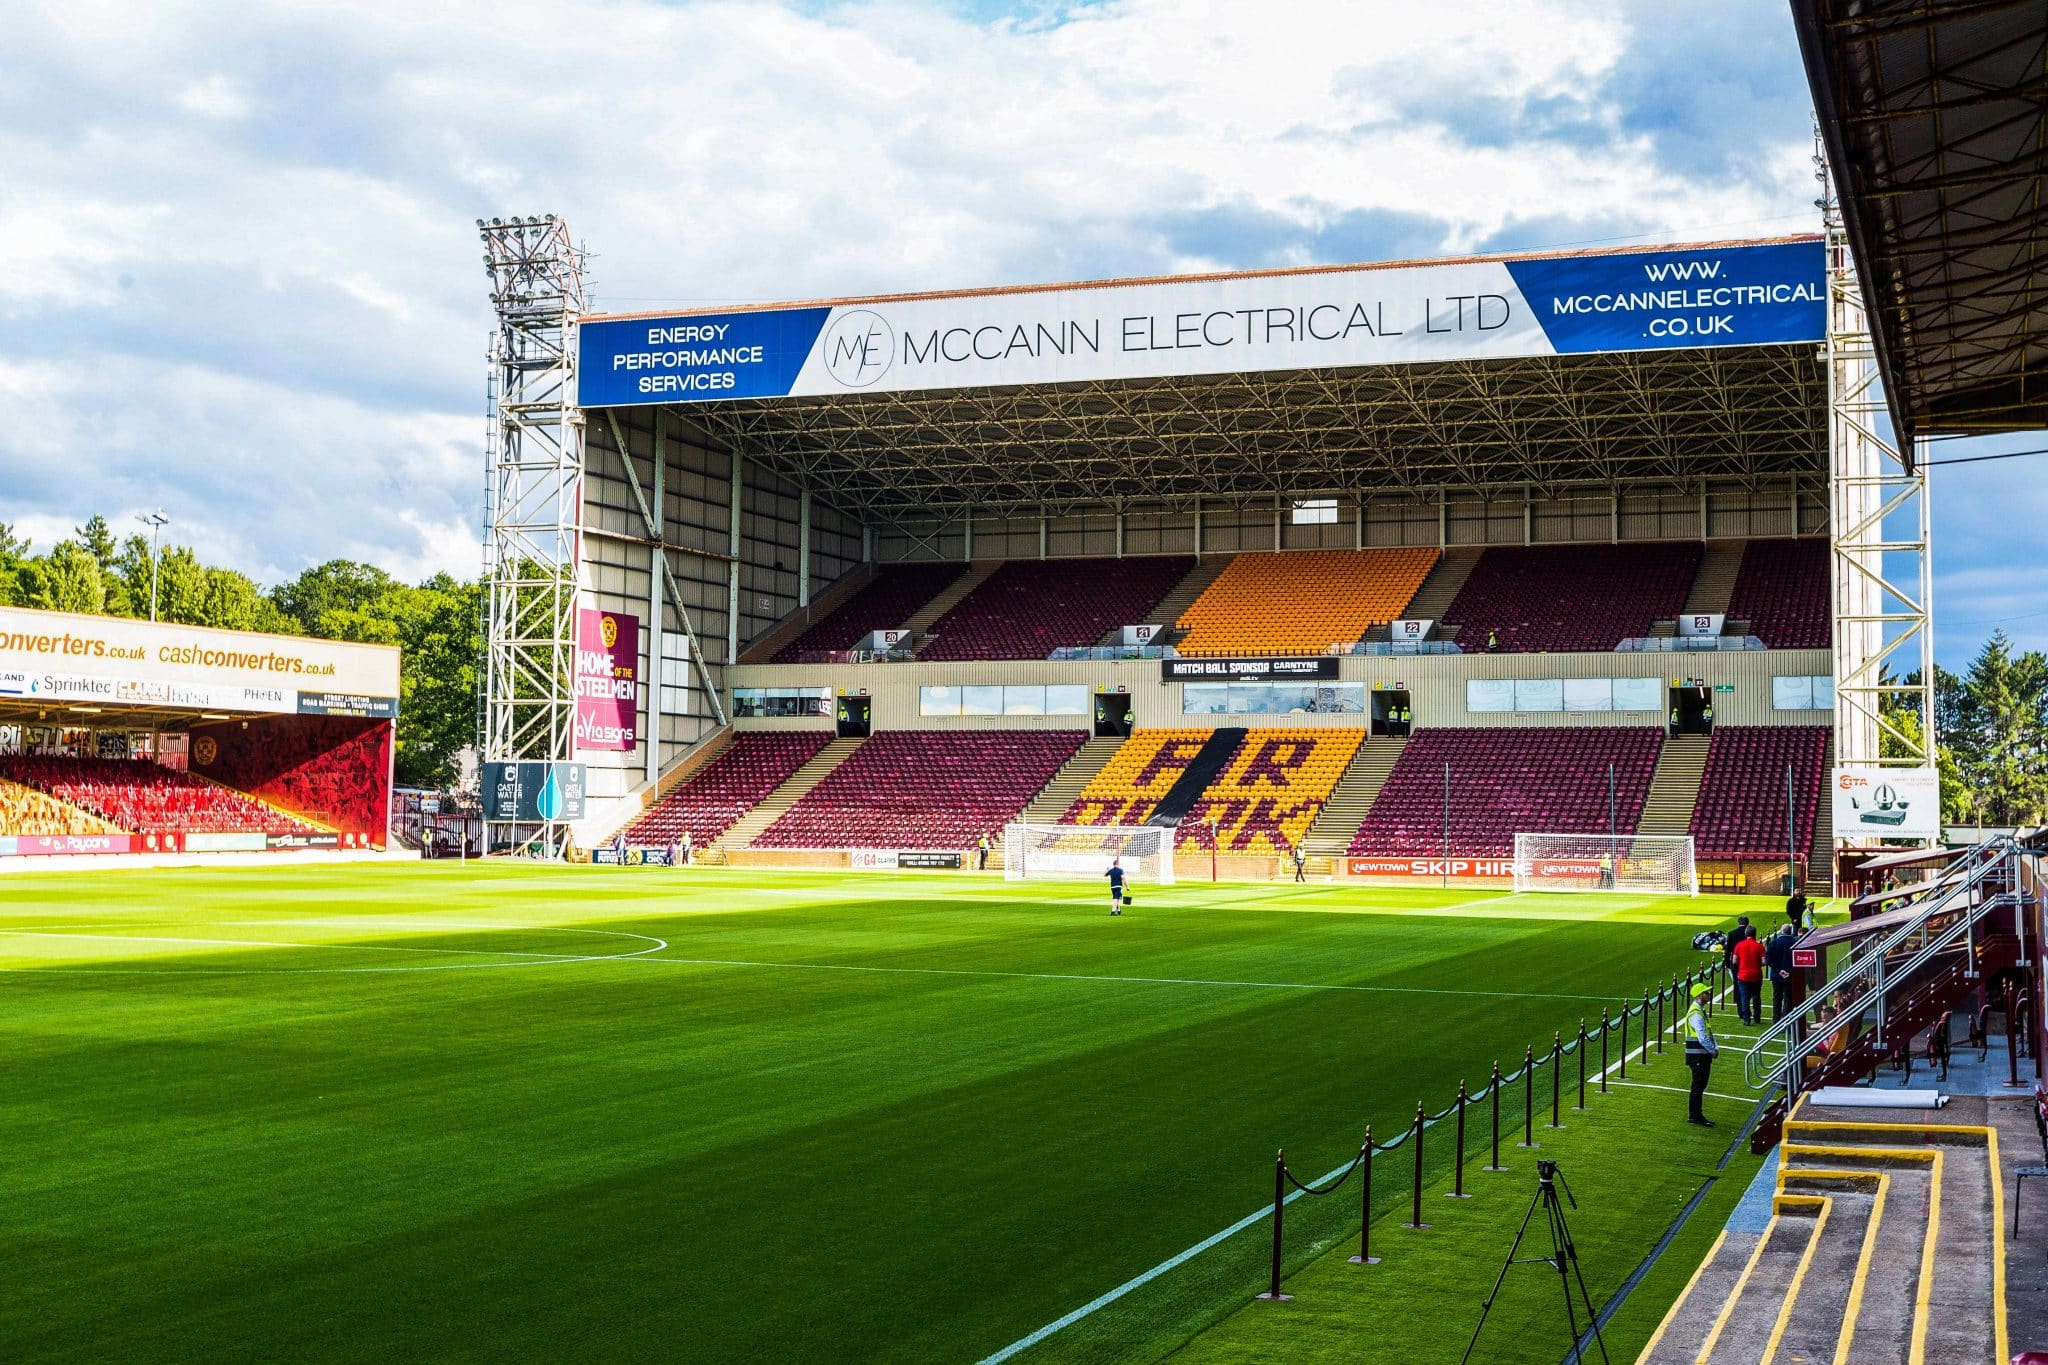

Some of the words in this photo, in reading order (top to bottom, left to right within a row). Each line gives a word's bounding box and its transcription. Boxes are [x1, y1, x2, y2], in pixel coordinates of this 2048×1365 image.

[1645, 261, 1727, 282] WWW.
[1553, 282, 1825, 314] MCCANNELECTRICAL
[648, 324, 730, 345] ENERGY
[903, 318, 1099, 365] MCCANN
[1121, 302, 1403, 352] ELECTRICAL
[1426, 294, 1510, 333] LTD
[1642, 315, 1734, 337] .CO.UK
[613, 346, 763, 370] PERFORMANCE
[638, 372, 735, 393] SERVICES
[886, 633, 896, 641] 20
[1138, 629, 1148, 637] 21
[1407, 624, 1418, 632] 22
[158, 644, 335, 675] cashconverters.co.uk
[577, 652, 614, 676] HOME
[614, 667, 622, 677] OF
[623, 668, 632, 678] THE
[1173, 663, 1203, 674] MATCH
[1205, 663, 1227, 673] BALL
[1229, 662, 1270, 673] SPONSOR
[1273, 661, 1318, 669] CARNTYNE
[0, 673, 25, 682] AND
[577, 676, 634, 700] STEELMEN
[1355, 863, 1408, 871] NEWTOWN
[1411, 861, 1468, 875] SKIP
[1544, 866, 1600, 875] NEWTOWN
